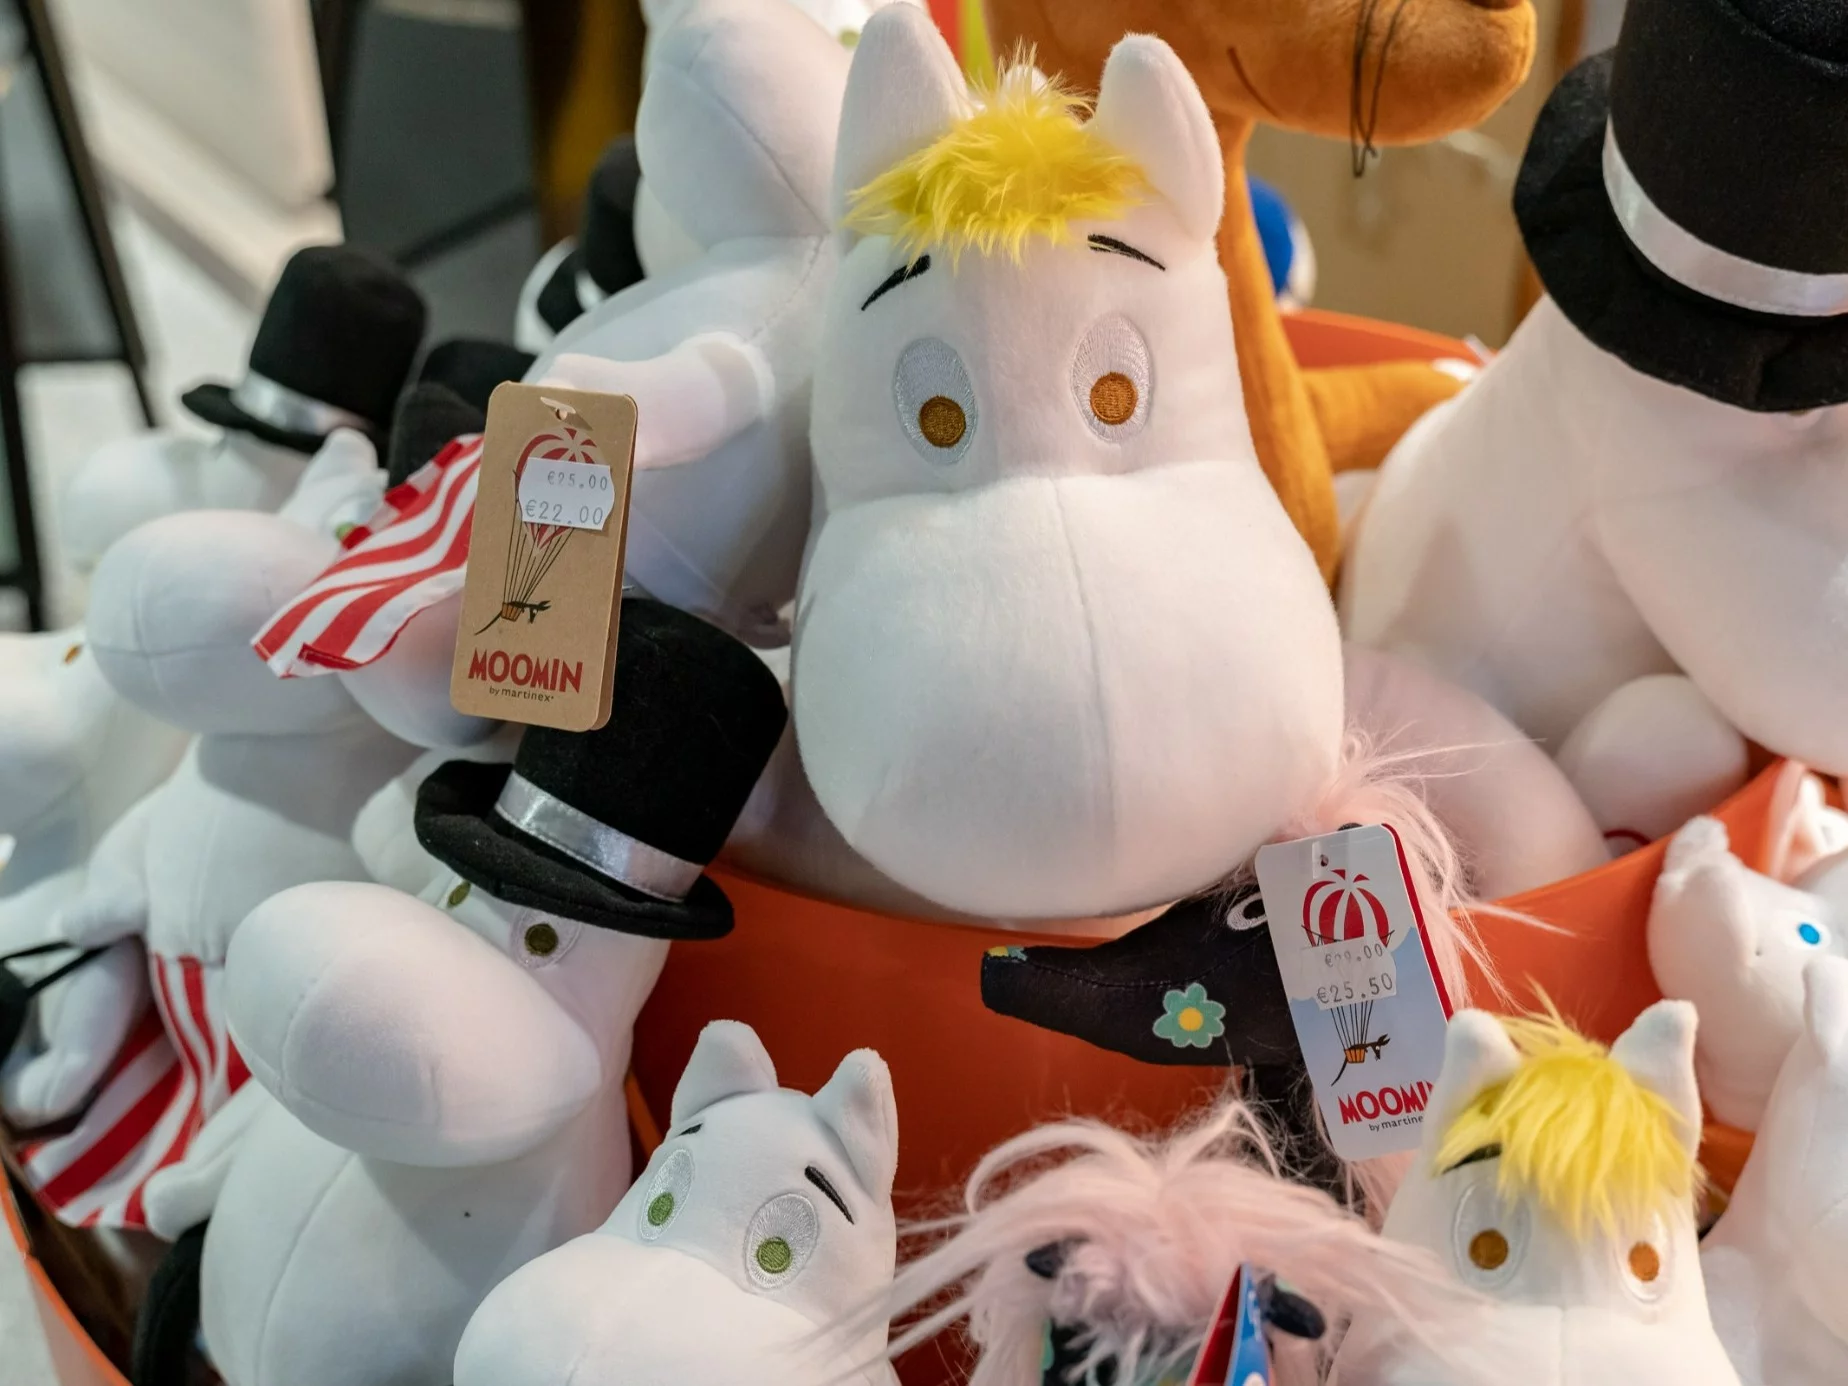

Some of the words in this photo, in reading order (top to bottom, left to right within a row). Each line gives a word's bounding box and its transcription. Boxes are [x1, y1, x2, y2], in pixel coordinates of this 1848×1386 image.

[525, 499, 604, 525] €22.00
[468, 647, 583, 694] MOOMIN
[489, 685, 500, 696] by
[501, 688, 551, 703] martinex
[1317, 972, 1392, 1004] €25.50
[1337, 1080, 1434, 1125] MOOMI
[1369, 1123, 1380, 1132] by
[1381, 1115, 1424, 1130] martine
